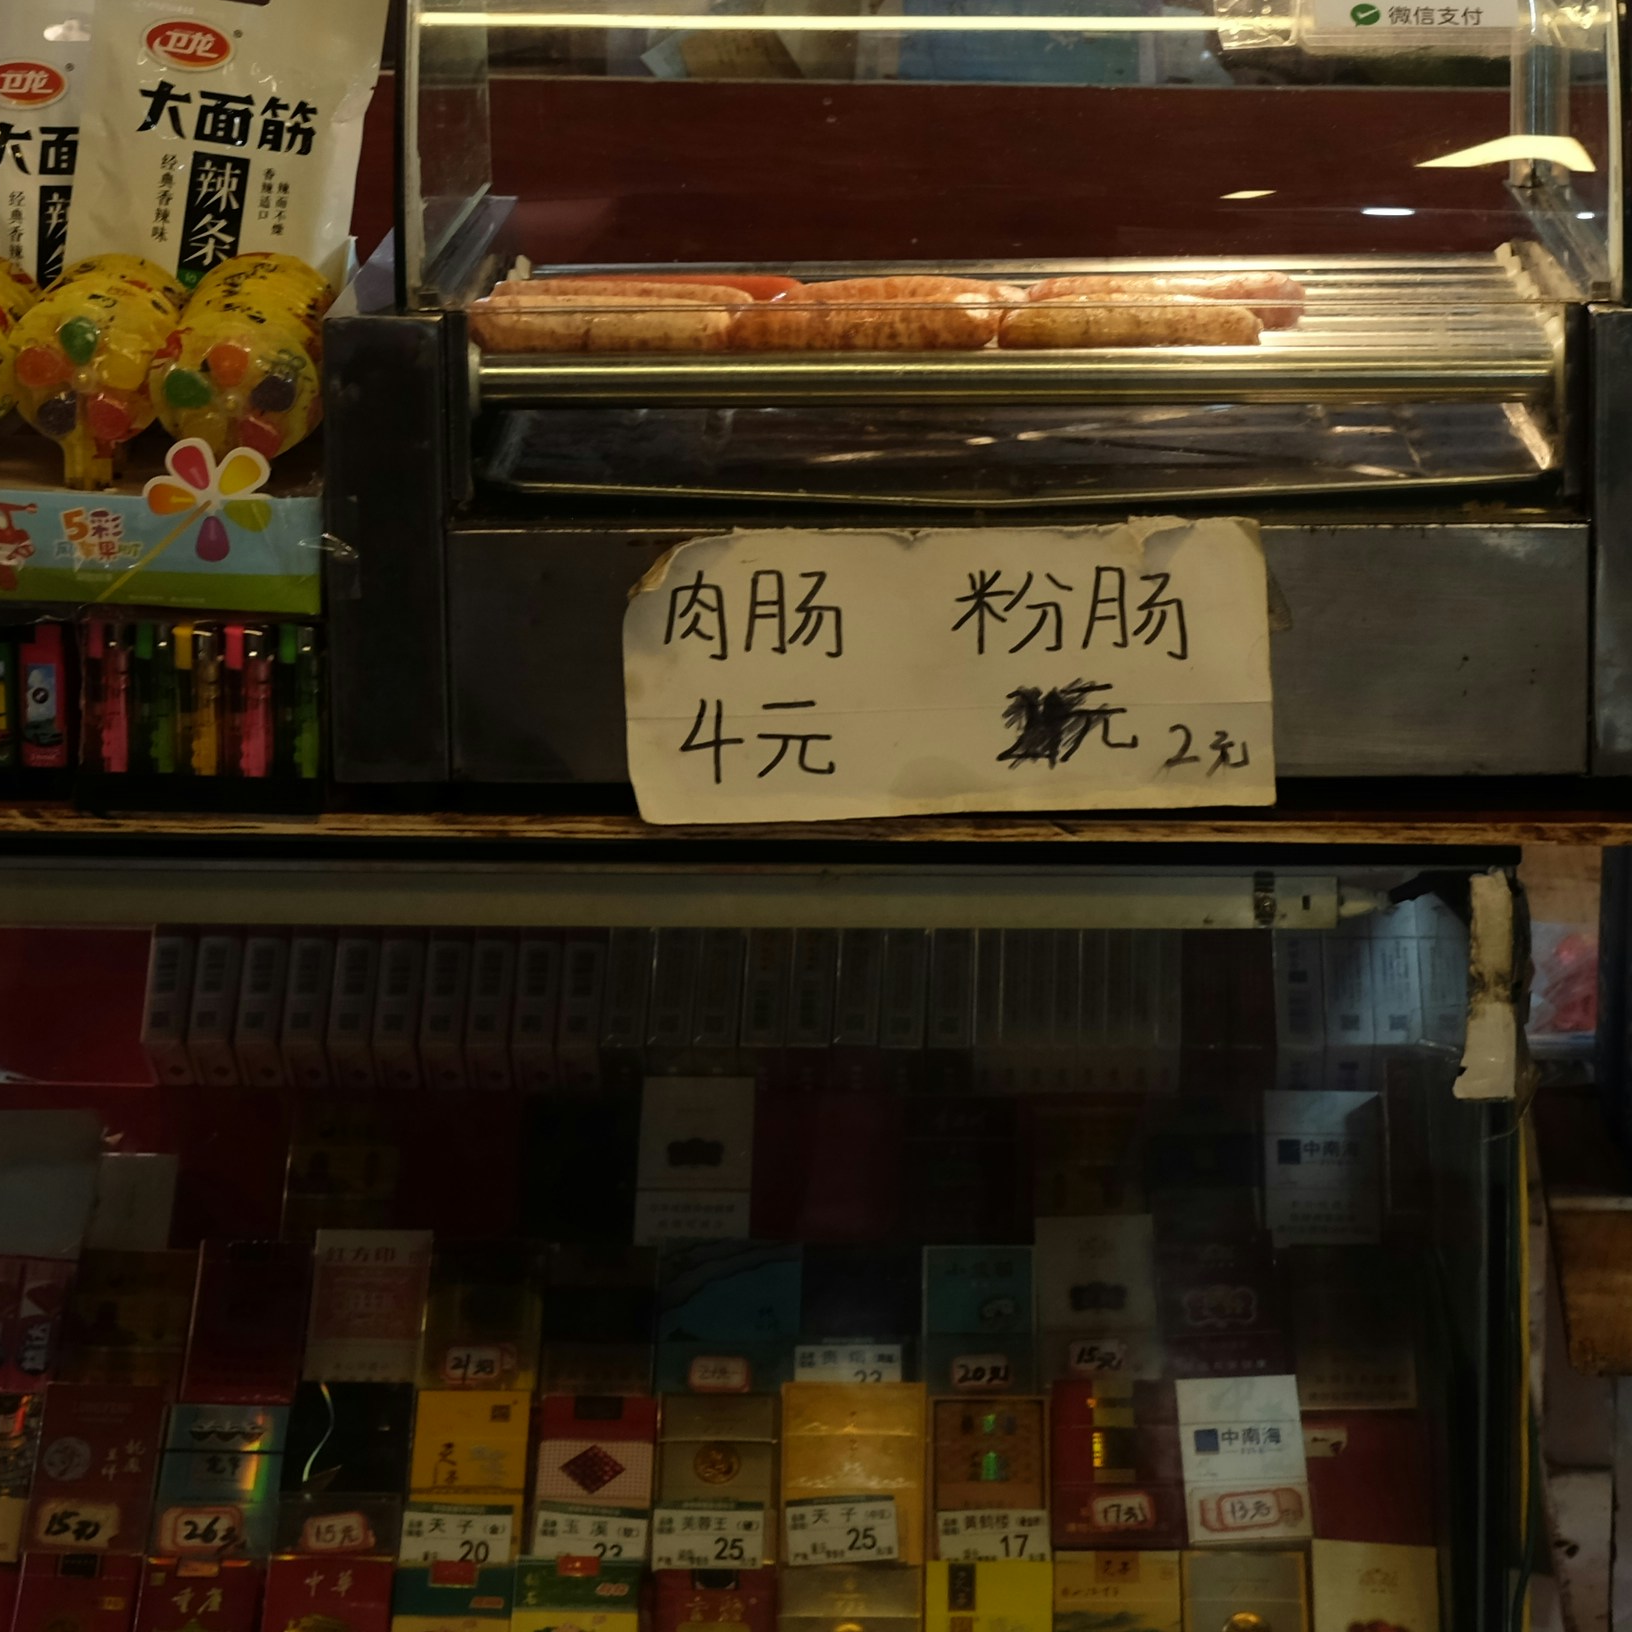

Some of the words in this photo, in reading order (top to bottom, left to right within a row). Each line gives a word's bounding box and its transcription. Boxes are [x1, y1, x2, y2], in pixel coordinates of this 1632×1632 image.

[1387, 5, 1484, 27] 微信支付
[136, 80, 319, 156] 大面筋
[151, 153, 179, 243] 经典香辣味
[183, 158, 245, 269] 辣条
[663, 568, 844, 660] 肉肠
[951, 565, 1188, 661] 粉肠
[679, 697, 836, 785] 4元
[1220, 1426, 1282, 1447] 中南海
[427, 1517, 475, 1534] 天子
[845, 1525, 879, 1552] 25
[458, 1539, 491, 1564] 20
[713, 1536, 746, 1562] 25
[998, 1534, 1030, 1559] 17
